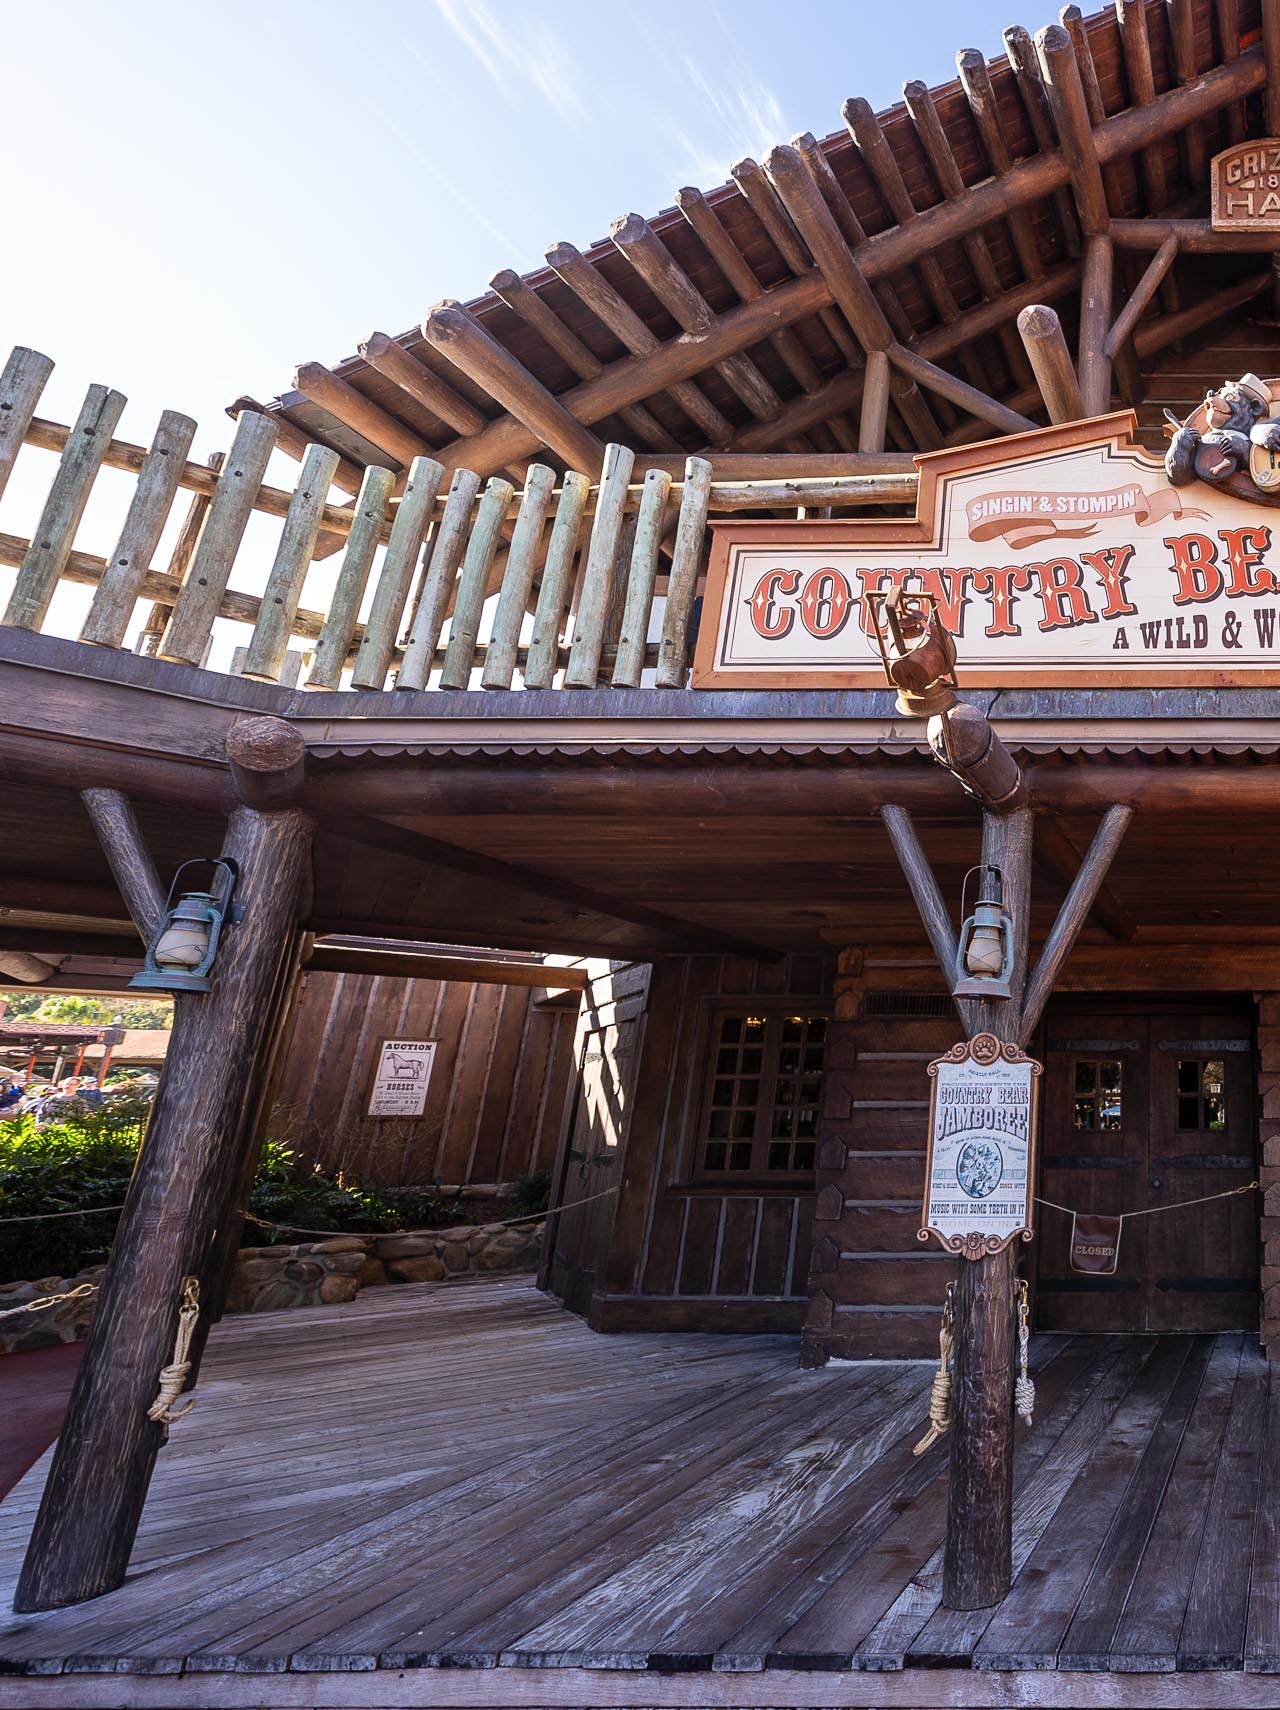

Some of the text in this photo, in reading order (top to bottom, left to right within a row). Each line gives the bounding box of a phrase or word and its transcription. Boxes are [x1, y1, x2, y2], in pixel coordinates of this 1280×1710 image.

[971, 488, 1140, 520] SINGIN' & STOMPIN'
[744, 545, 1138, 640] COUNTRY
[1113, 627, 1129, 649] A
[1140, 614, 1208, 649] WILD
[1222, 610, 1243, 649] &
[385, 1043, 432, 1051] AUCTION
[386, 1083, 415, 1091] HORSES
[940, 1087, 1028, 1104] COUNTRY BEAR
[936, 1106, 1028, 1141] JAMBOREE
[930, 1204, 1024, 1214] MUSIC WITH SOME TEETH IN IT
[1075, 1246, 1115, 1256] CLOSED
